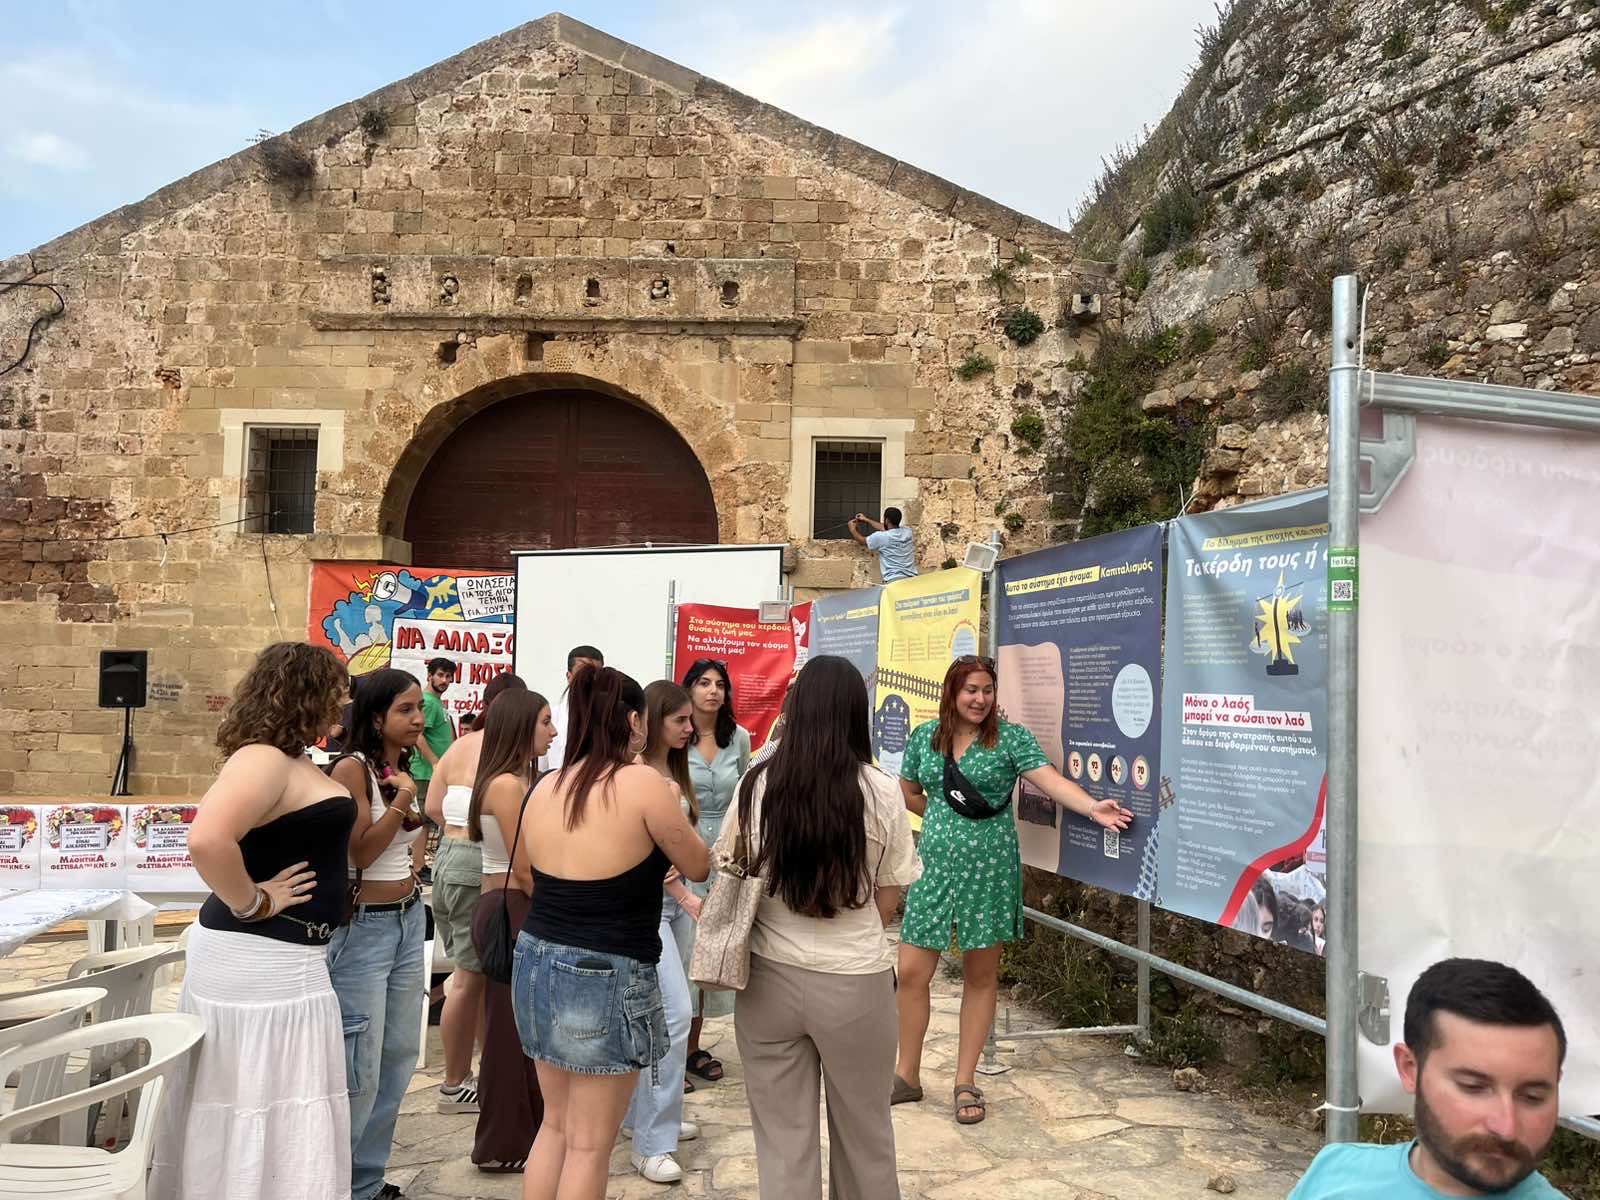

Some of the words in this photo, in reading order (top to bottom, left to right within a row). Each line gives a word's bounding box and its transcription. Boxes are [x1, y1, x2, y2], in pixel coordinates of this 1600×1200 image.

[1217, 536, 1248, 549] δίλημμα
[1250, 535, 1264, 544] της
[1200, 552, 1252, 579] κέρδη
[1259, 548, 1300, 570] τους
[1305, 542, 1318, 570] ή
[1006, 581, 1020, 592] Αυτό
[1021, 582, 1028, 590] το
[1029, 576, 1056, 592] σύστημα
[1056, 572, 1068, 587] έχει
[1069, 570, 1092, 586] όνομα:
[1100, 557, 1153, 578] Καπιταλισμός
[462, 592, 474, 600] ΓΙΑ
[478, 596, 509, 604] ΤΕΜΠΗ
[468, 608, 480, 616] ΓΙΑ
[484, 604, 505, 614] ΤΟΥΣ
[688, 616, 704, 624] Στο
[706, 618, 740, 629] σύστημα
[688, 624, 712, 633] θυσία
[722, 627, 736, 636] ζωή
[396, 626, 426, 650] ΝΑ
[433, 629, 514, 654] ΑΛΛΑΞΟ
[688, 635, 700, 643] Να
[702, 636, 745, 648] αλλάξουμε
[762, 642, 788, 650] κόσμο
[694, 643, 726, 654] επιλογή
[470, 662, 513, 684] ΚΟΣ
[1185, 694, 1210, 709] Μόνο
[1212, 698, 1218, 708] ο
[1222, 696, 1250, 714] λαός
[1184, 710, 1214, 724] μπορεί
[1216, 712, 1229, 722] να
[1234, 711, 1264, 725] σώσει
[1266, 716, 1282, 725] τον
[1285, 712, 1306, 728] λαό
[1182, 727, 1198, 736] Στον
[1218, 731, 1230, 740] της
[1232, 731, 1275, 744] ανατροπής
[1276, 733, 1297, 744] αυτού
[1298, 736, 1312, 744] του
[1205, 740, 1214, 748] και
[1214, 739, 1269, 754] διεφθαρμένου
[1271, 742, 1318, 756] συστήματος!
[1072, 759, 1079, 768] 75
[1091, 760, 1098, 770] 93
[1137, 766, 1144, 774] 70
